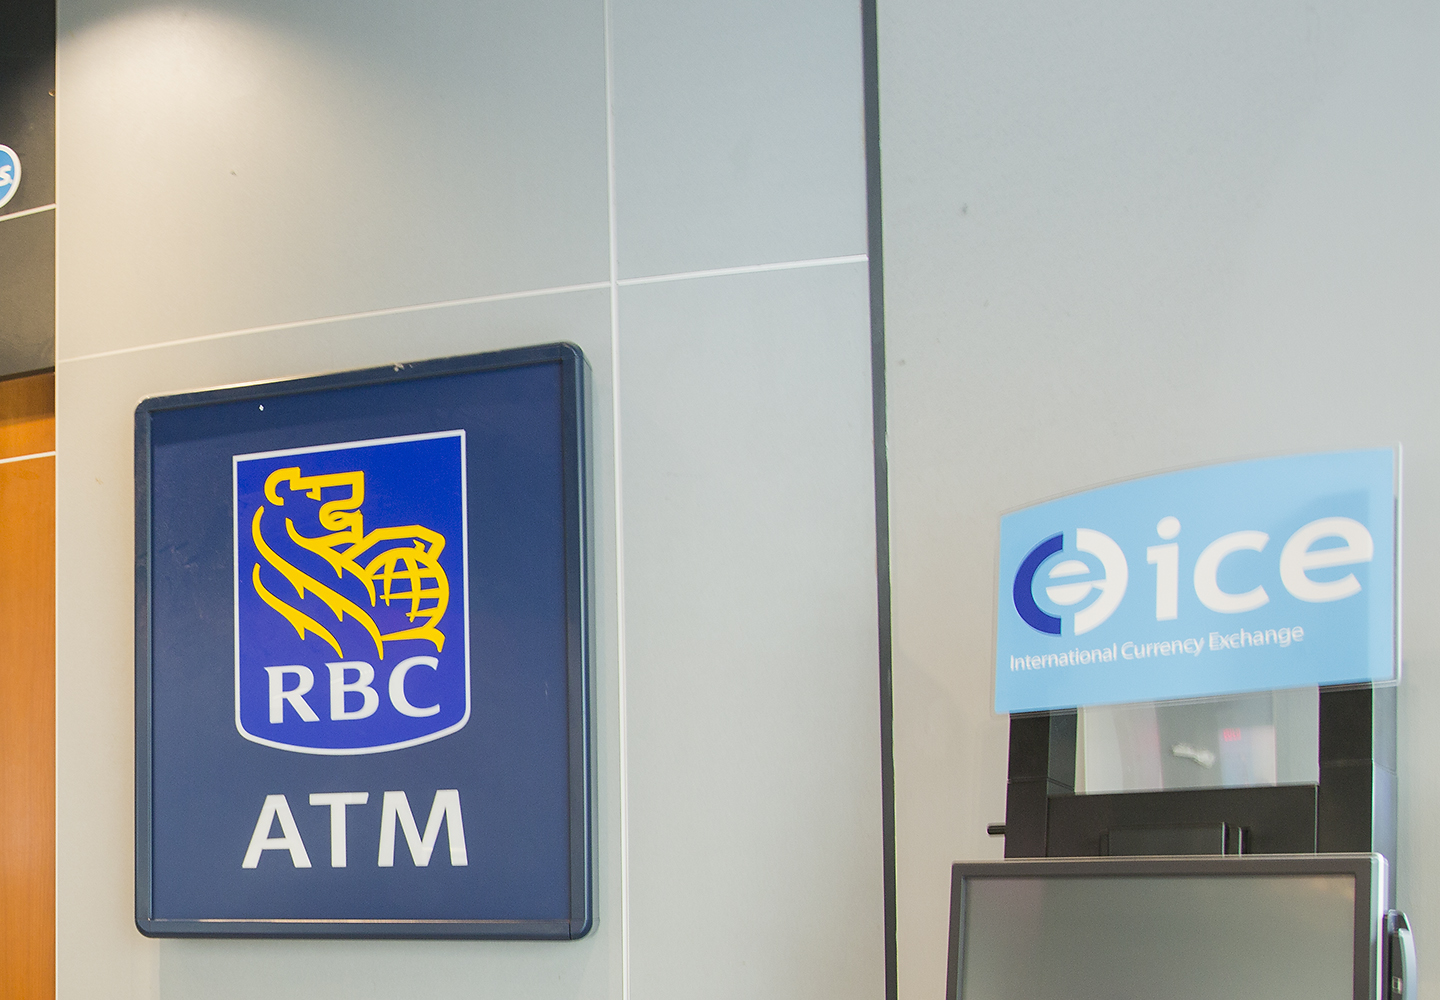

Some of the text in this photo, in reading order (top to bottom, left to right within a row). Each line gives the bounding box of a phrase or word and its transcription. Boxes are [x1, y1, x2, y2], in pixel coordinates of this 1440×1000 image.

[1146, 516, 1374, 621] ice
[1010, 625, 1304, 671] International Currency Exchange
[263, 655, 441, 723] RBC
[241, 789, 469, 869] ATM
